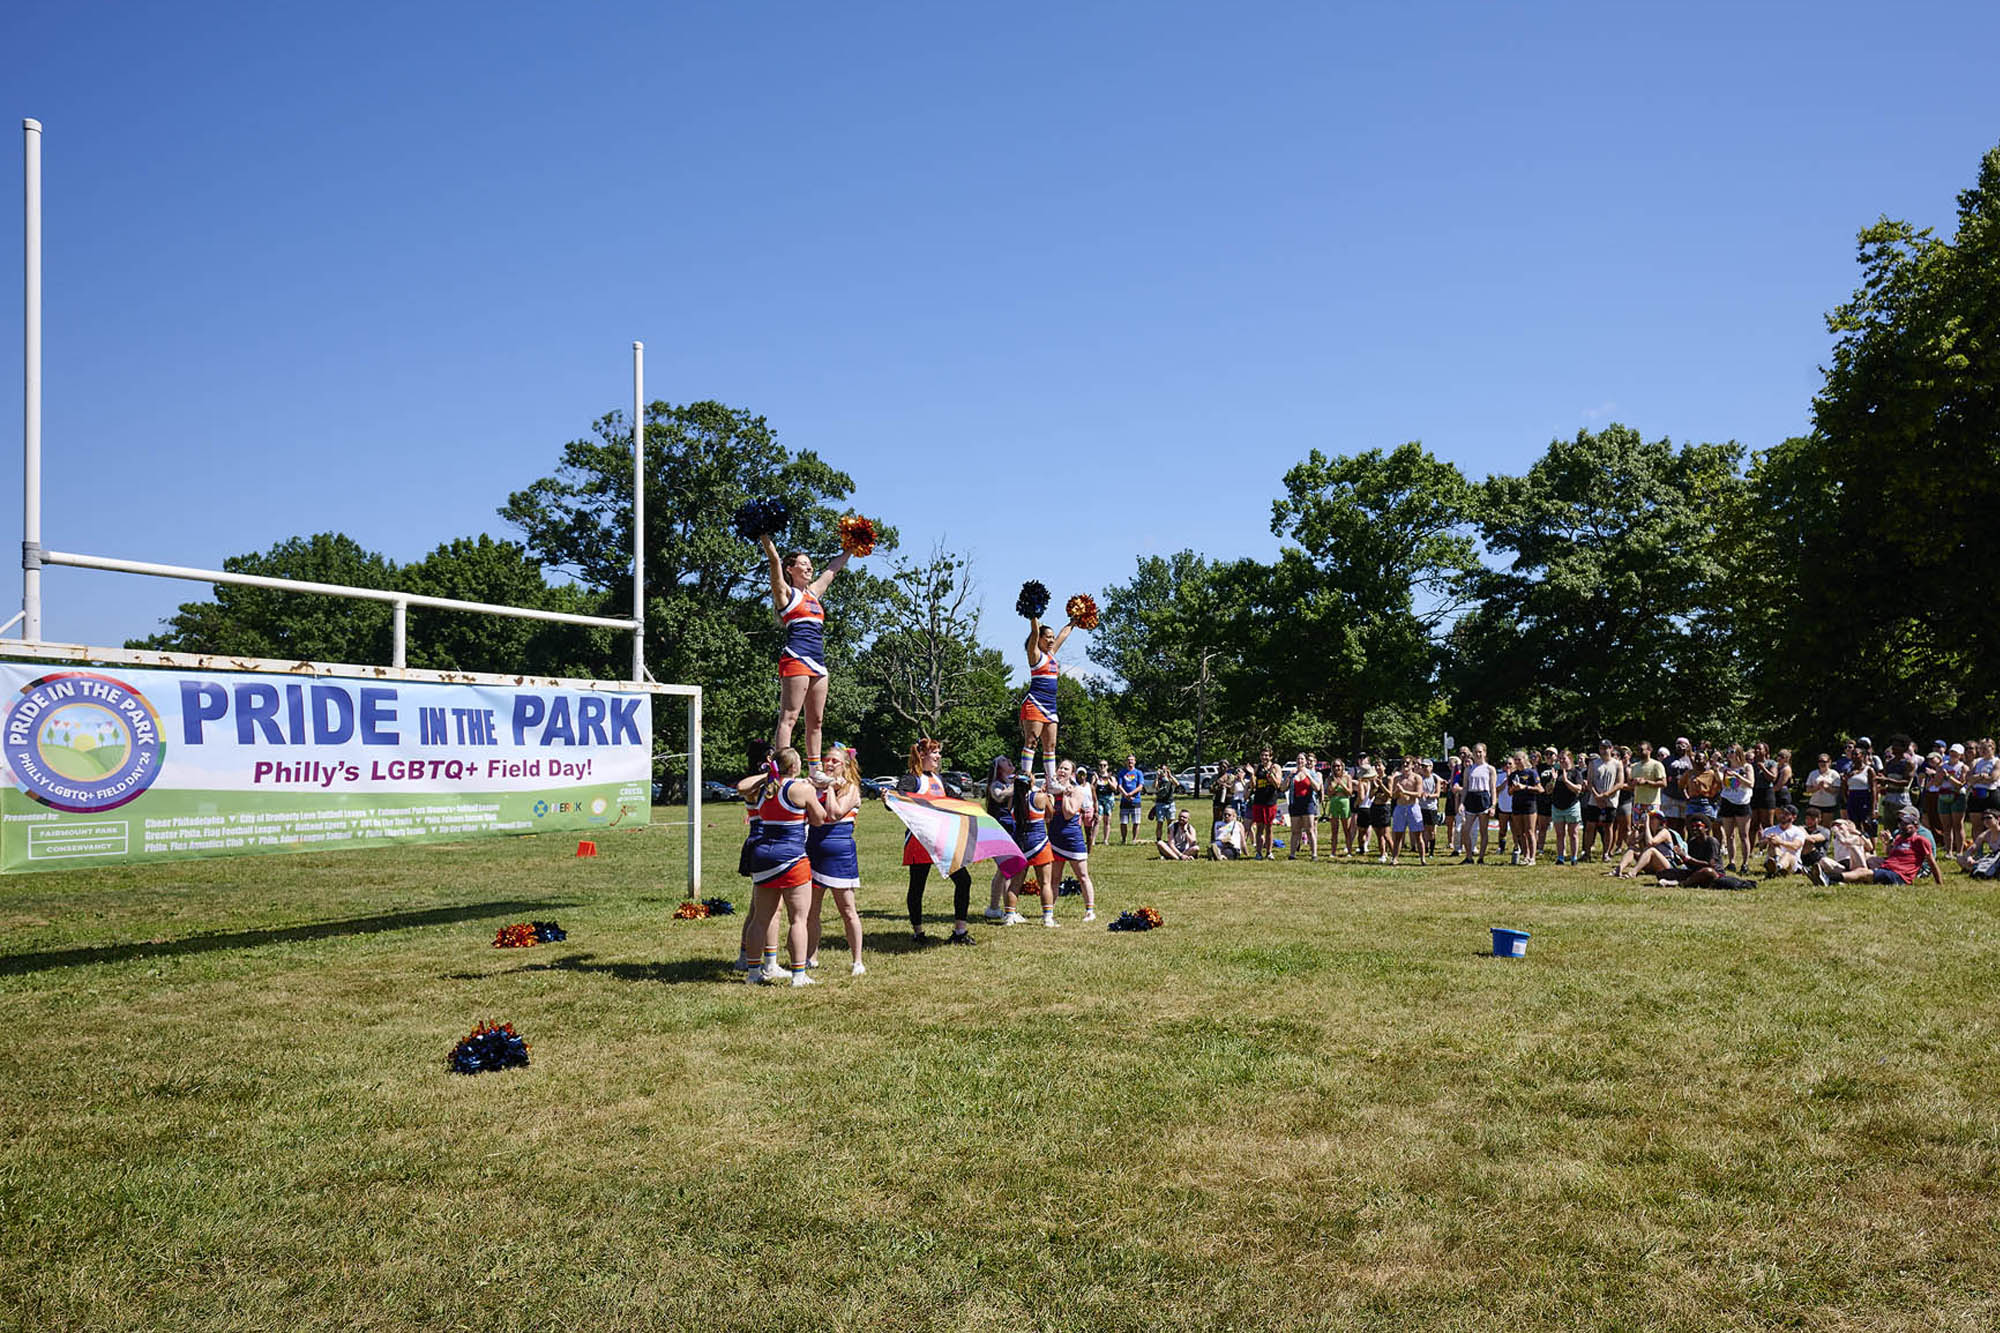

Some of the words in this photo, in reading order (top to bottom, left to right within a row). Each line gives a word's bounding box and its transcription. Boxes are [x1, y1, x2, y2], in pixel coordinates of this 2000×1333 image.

[9, 692, 50, 745] PRIDE
[46, 681, 76, 701] IN
[80, 681, 122, 704] THE
[119, 698, 155, 745] PARK
[179, 680, 400, 746] PRIDE
[418, 706, 448, 746] IN
[451, 707, 499, 746] THE
[512, 694, 643, 746] PARK
[18, 752, 49, 786] PHILLY
[47, 782, 95, 802] LGBTQ+
[96, 782, 127, 800] FIELD
[125, 765, 145, 786] DAY
[254, 760, 360, 788] Philly's
[371, 760, 478, 781] LGBTQ+
[487, 759, 541, 778] Field
[549, 758, 592, 780] Day!
[46, 843, 113, 853] CONSERVANCY
